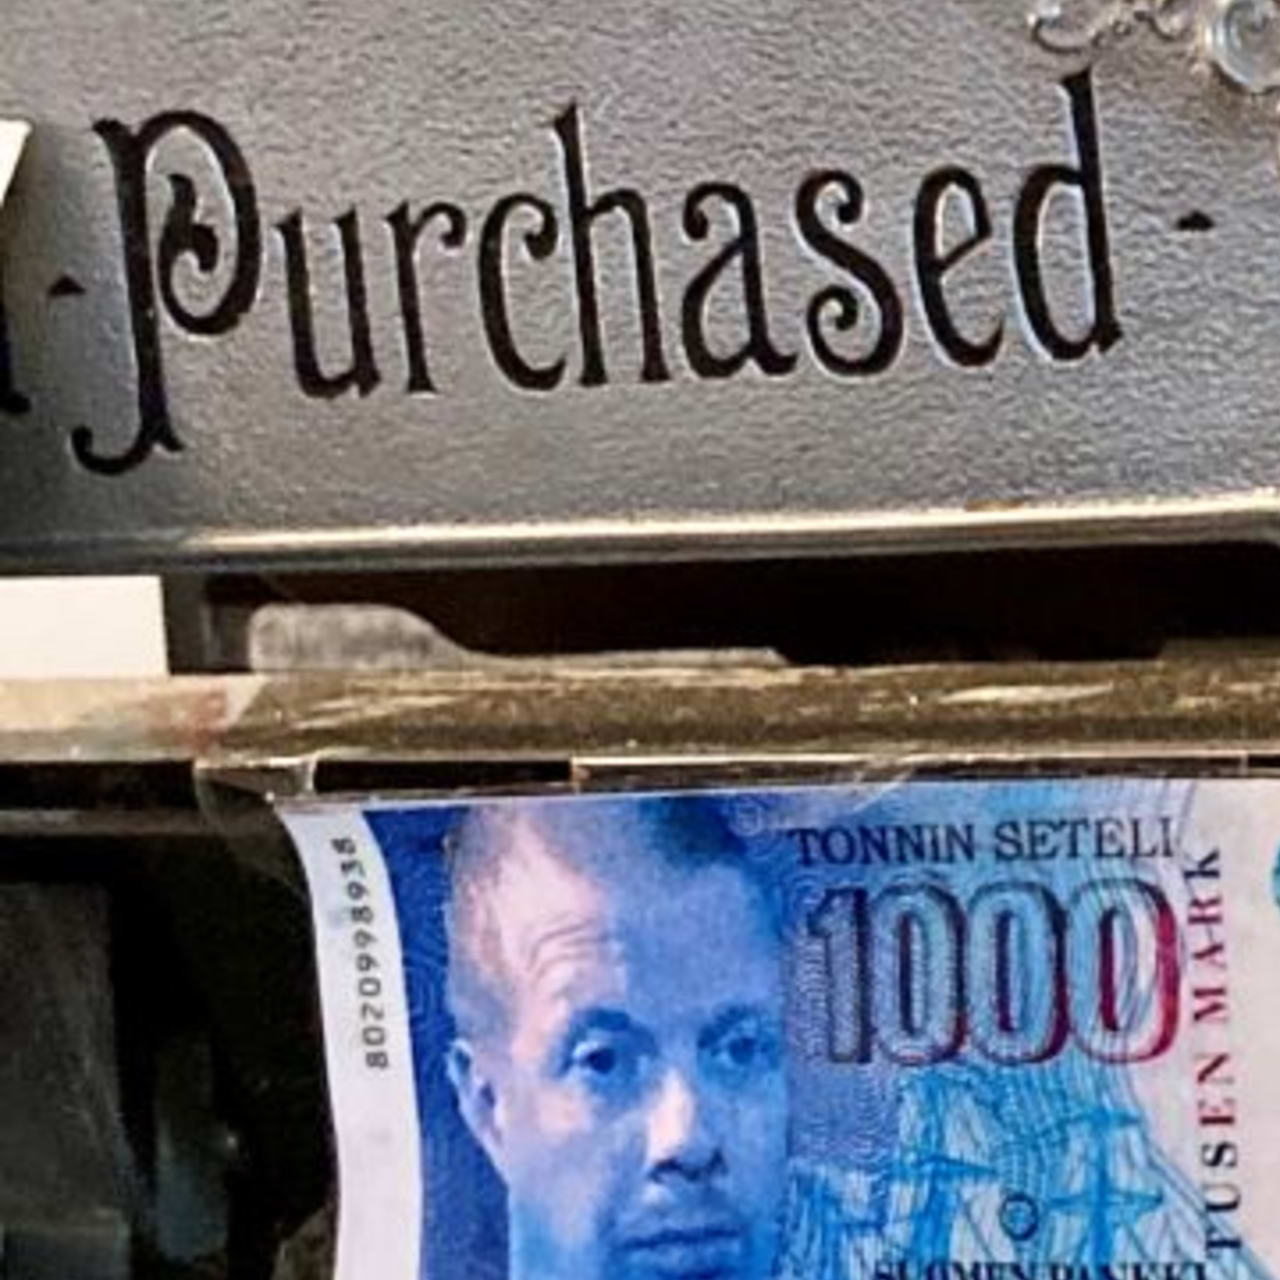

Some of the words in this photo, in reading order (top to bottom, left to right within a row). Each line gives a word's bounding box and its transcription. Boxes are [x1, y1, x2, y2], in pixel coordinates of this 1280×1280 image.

[71, 66, 1124, 476] Purchased
[790, 823, 977, 867] TONNIN
[988, 817, 1174, 861] SETELI
[1182, 844, 1231, 1029] MARK
[806, 875, 1184, 1066] 1000
[1196, 1051, 1244, 1255] TUSEN
